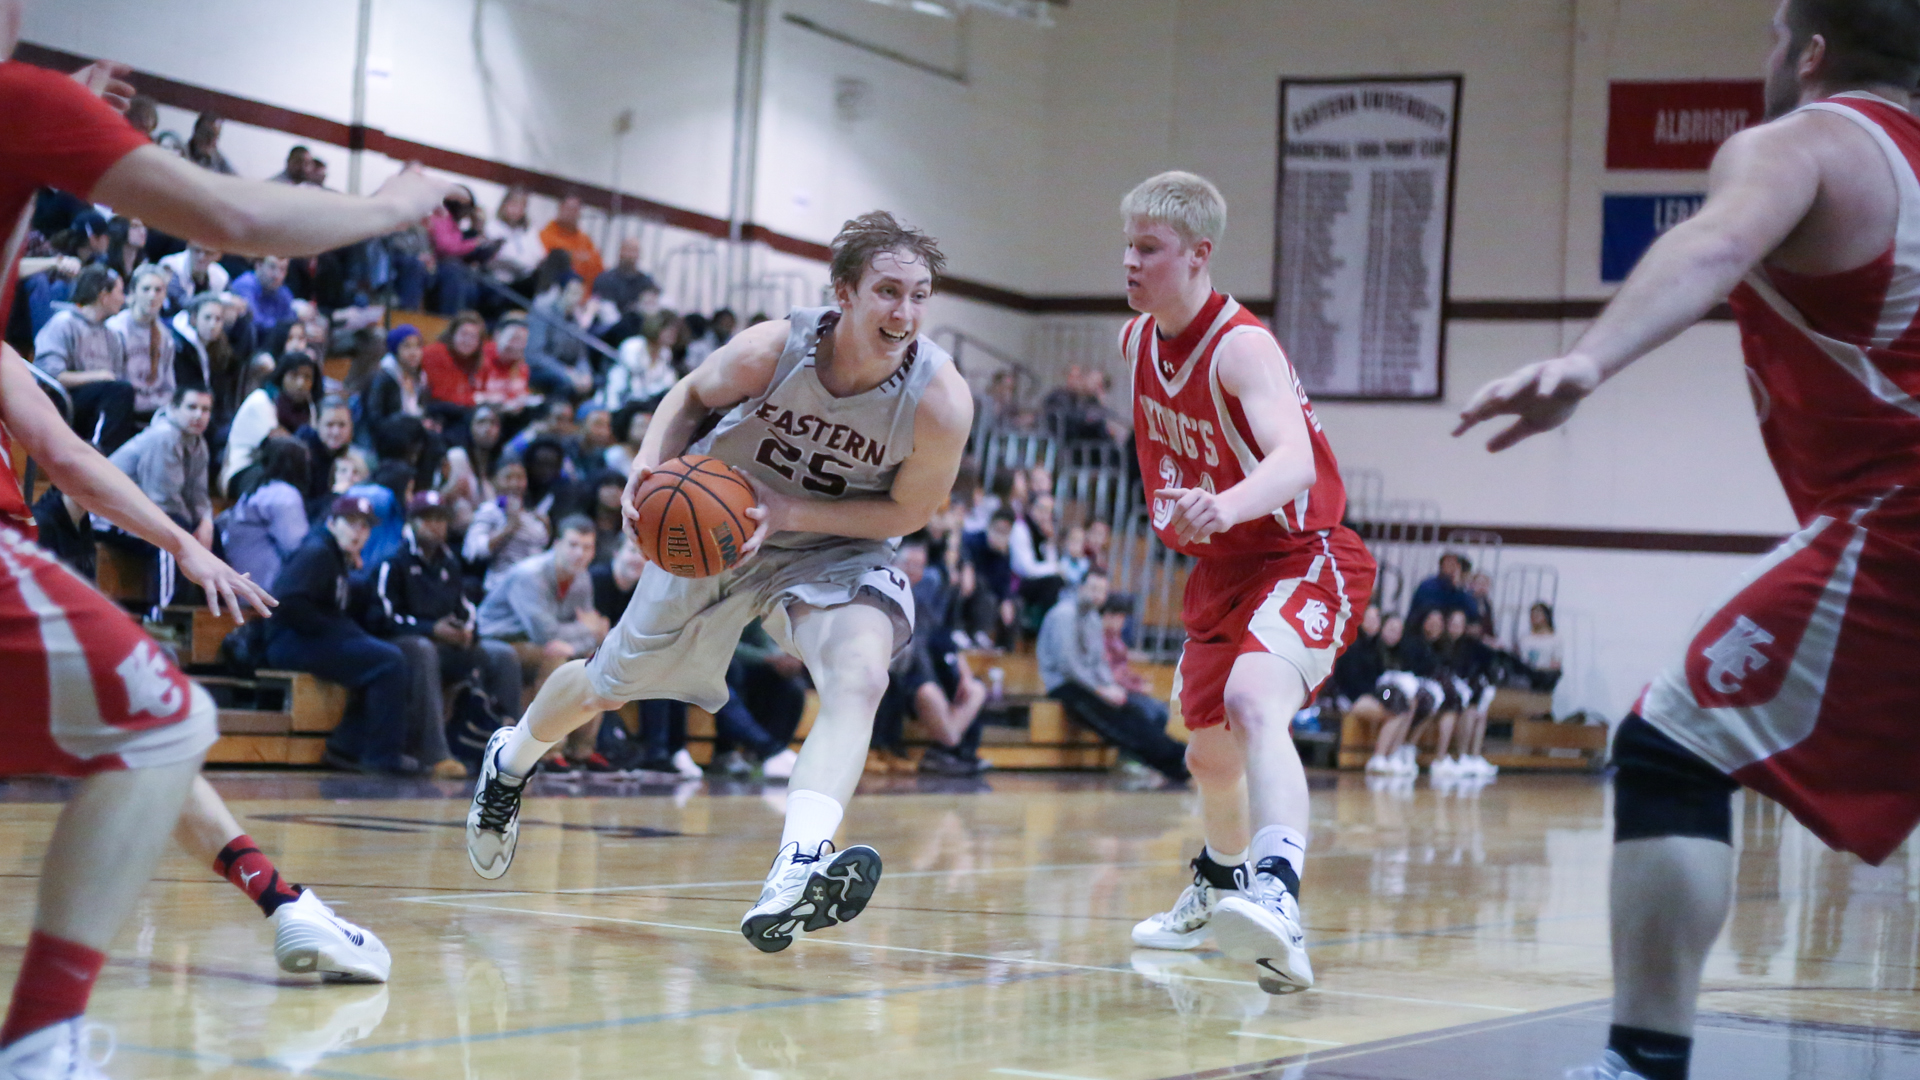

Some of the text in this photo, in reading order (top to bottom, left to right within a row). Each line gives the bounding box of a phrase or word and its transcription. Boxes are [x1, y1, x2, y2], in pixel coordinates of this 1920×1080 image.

[1654, 108, 1748, 144] ALBRIGHT
[755, 402, 886, 466] EASTERN
[755, 429, 853, 496] 25
[667, 523, 692, 558] THE
